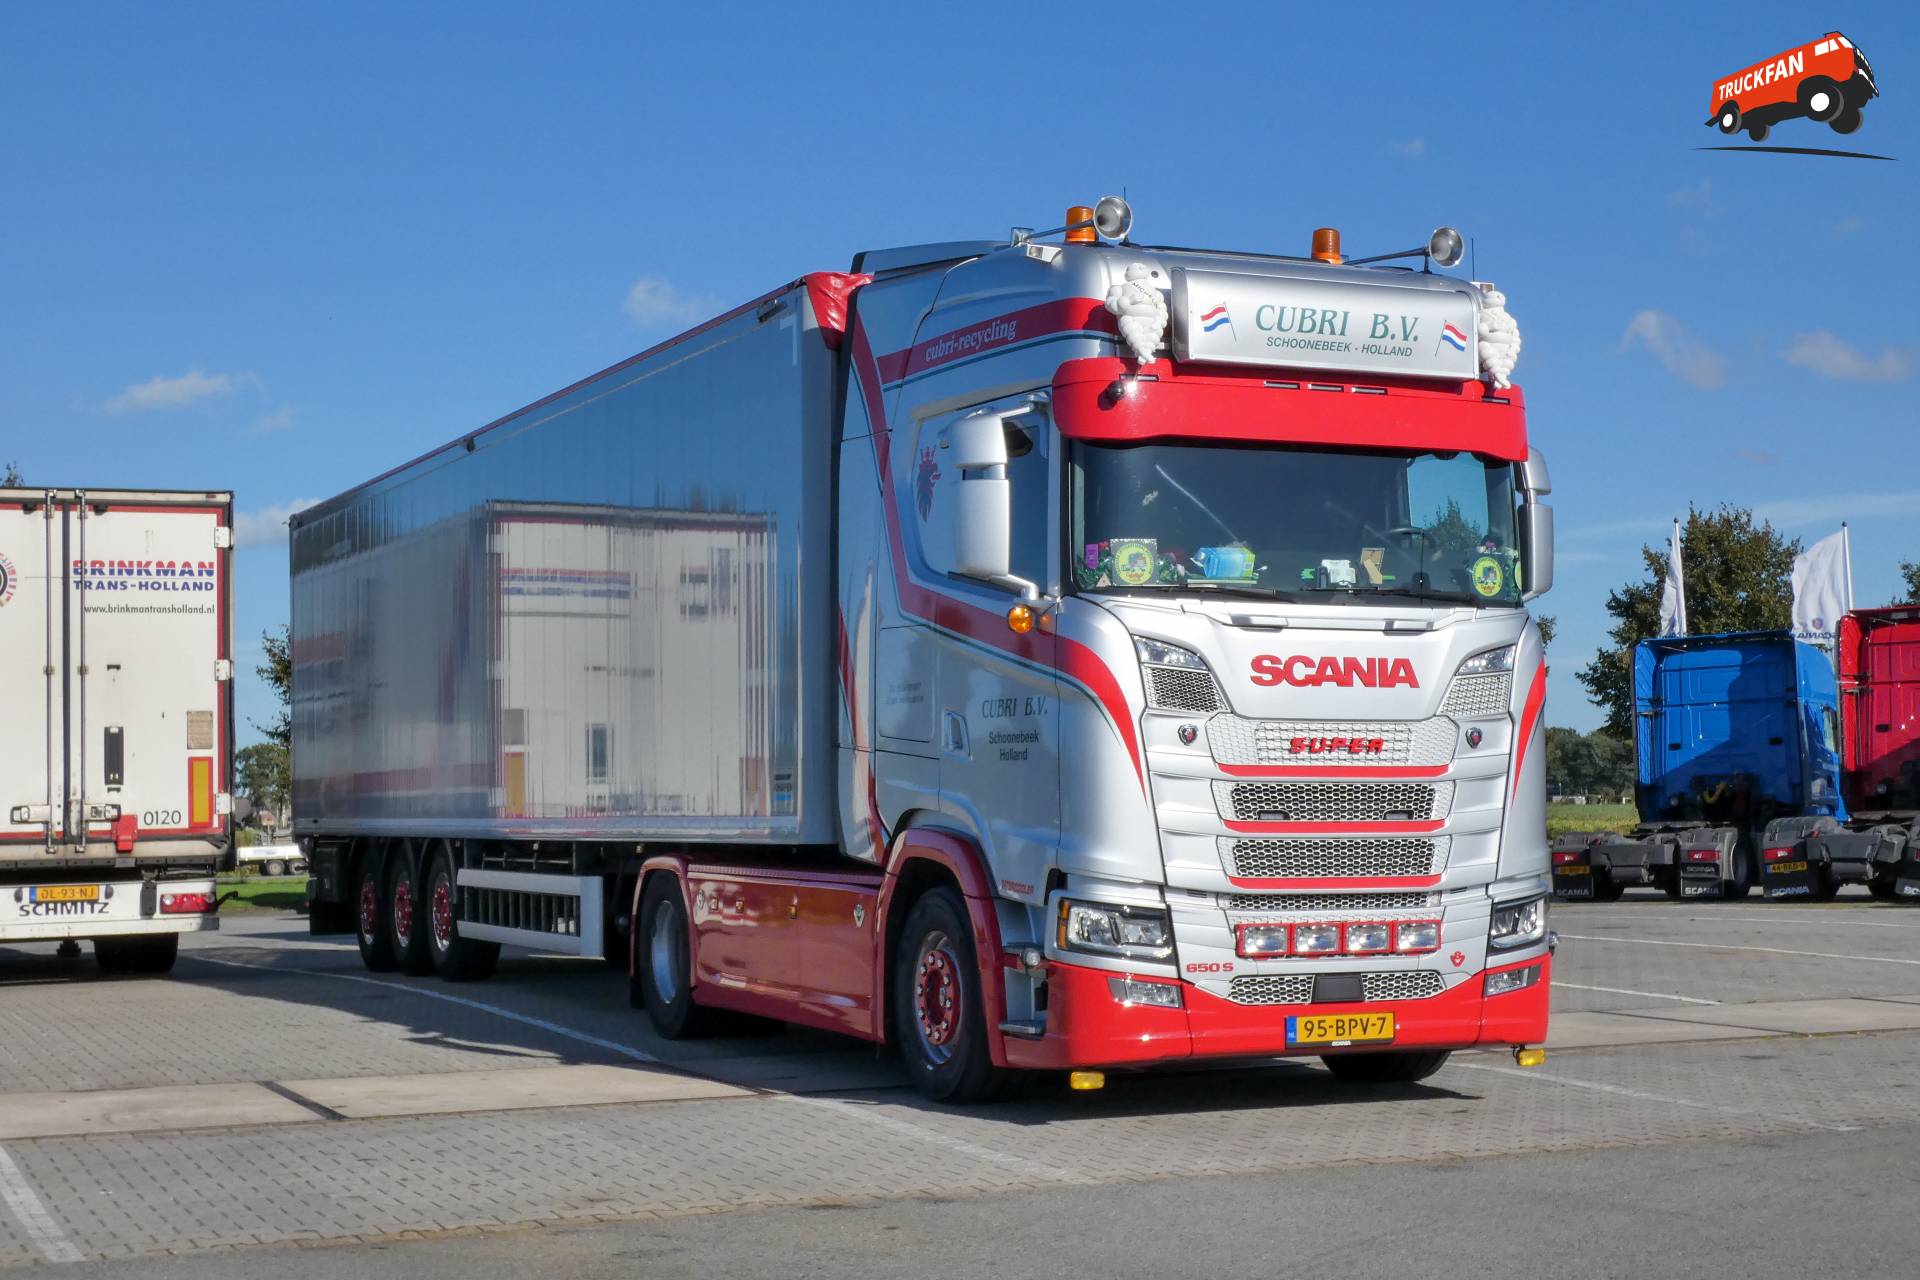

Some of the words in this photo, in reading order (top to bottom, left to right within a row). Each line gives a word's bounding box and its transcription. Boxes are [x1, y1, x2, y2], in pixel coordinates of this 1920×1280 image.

[1255, 304, 1351, 336] CUBRI
[1370, 314, 1419, 342] B.V.
[925, 319, 1017, 362] cubri-recycling
[1266, 336, 1352, 354] SCHOONEBEEK
[1361, 345, 1413, 357] HOLLAND
[72, 559, 215, 577] BRINKMAN
[73, 580, 214, 591] TRANS-HOLLAND
[84, 603, 215, 614] www.brinkmantransholland.nl
[1250, 654, 1420, 688] SCANIA
[982, 698, 1017, 718] CUBRI
[1024, 696, 1048, 716] B.V.
[989, 729, 1039, 744] Schoonebeek
[1289, 736, 1385, 754] SUPER
[1000, 747, 1028, 760] Holland
[143, 810, 181, 825] 0120
[19, 901, 110, 917] SCHMITZ
[1186, 963, 1220, 973] 650
[1222, 962, 1233, 971] S
[1304, 1017, 1386, 1038] 95-BPV-7
